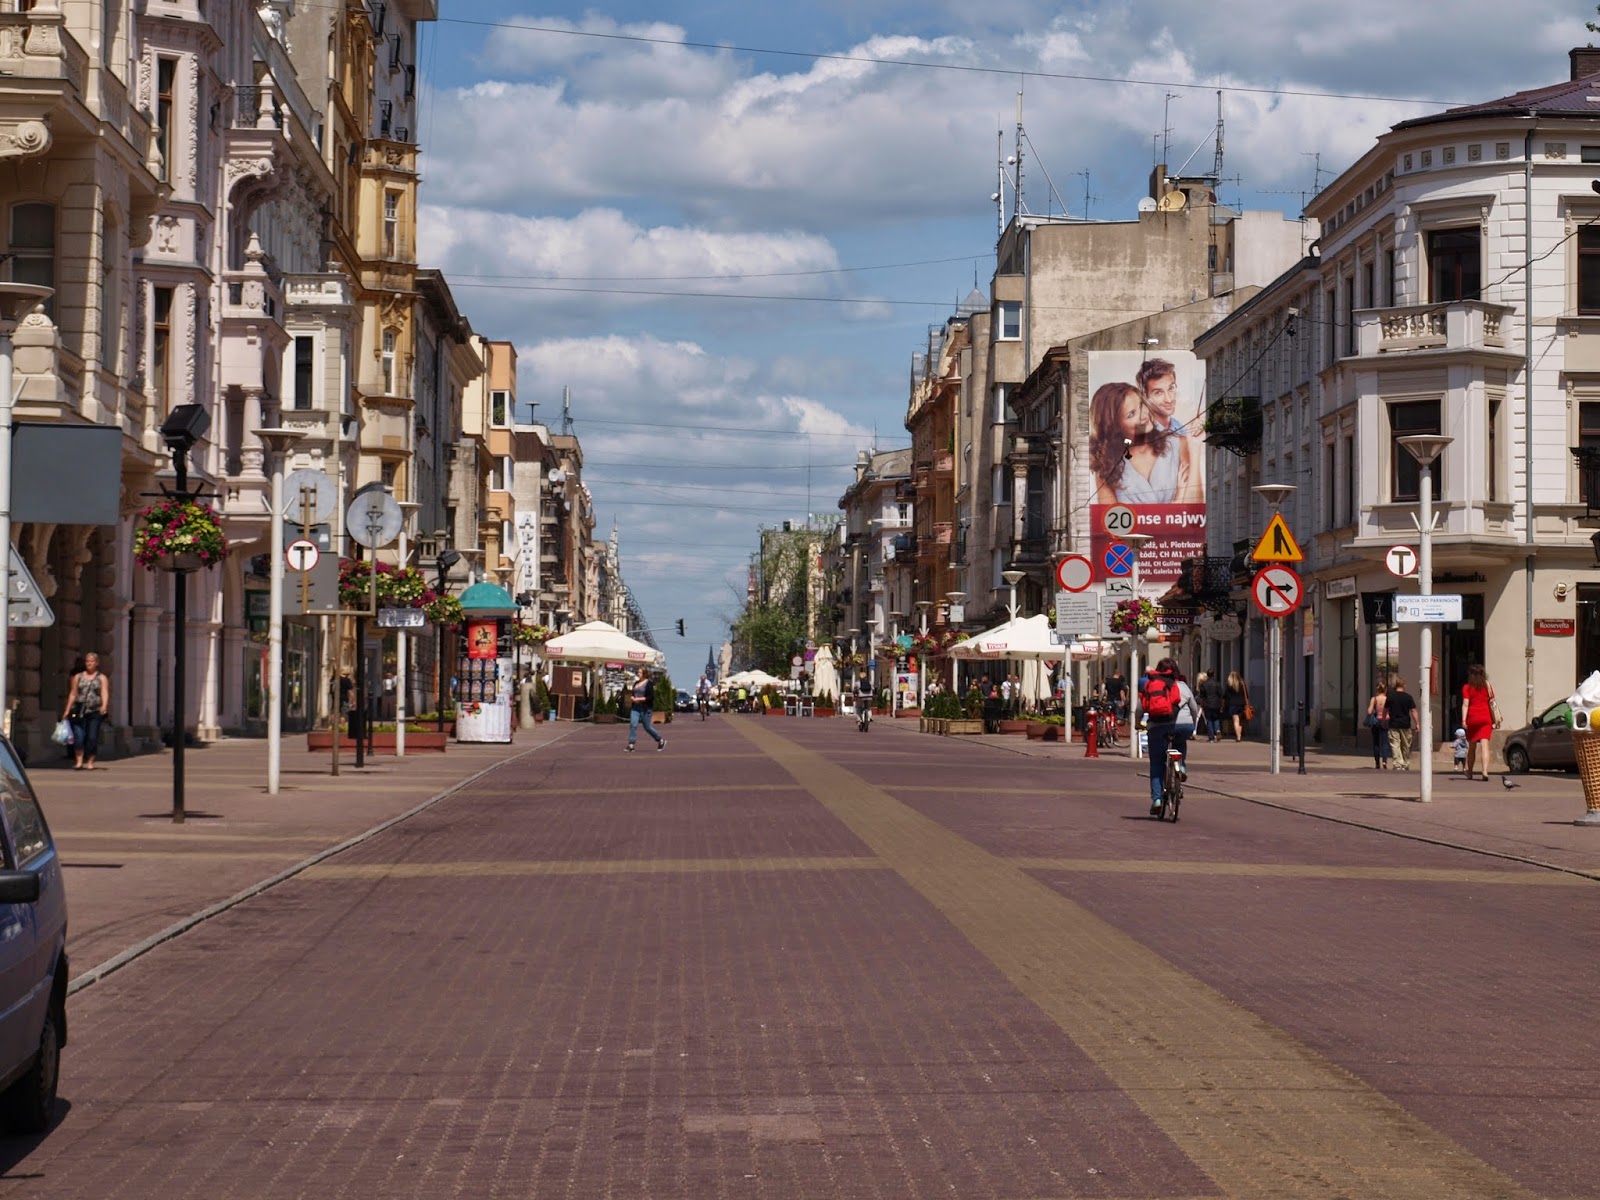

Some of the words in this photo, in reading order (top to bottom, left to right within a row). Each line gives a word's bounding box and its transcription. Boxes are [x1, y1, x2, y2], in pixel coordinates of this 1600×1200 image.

[1108, 512, 1131, 529] 20
[1137, 514, 1161, 524] nse
[1166, 511, 1206, 527] najwy
[1143, 541, 1158, 549] ódź,
[293, 546, 313, 570] T
[1392, 551, 1411, 574] T
